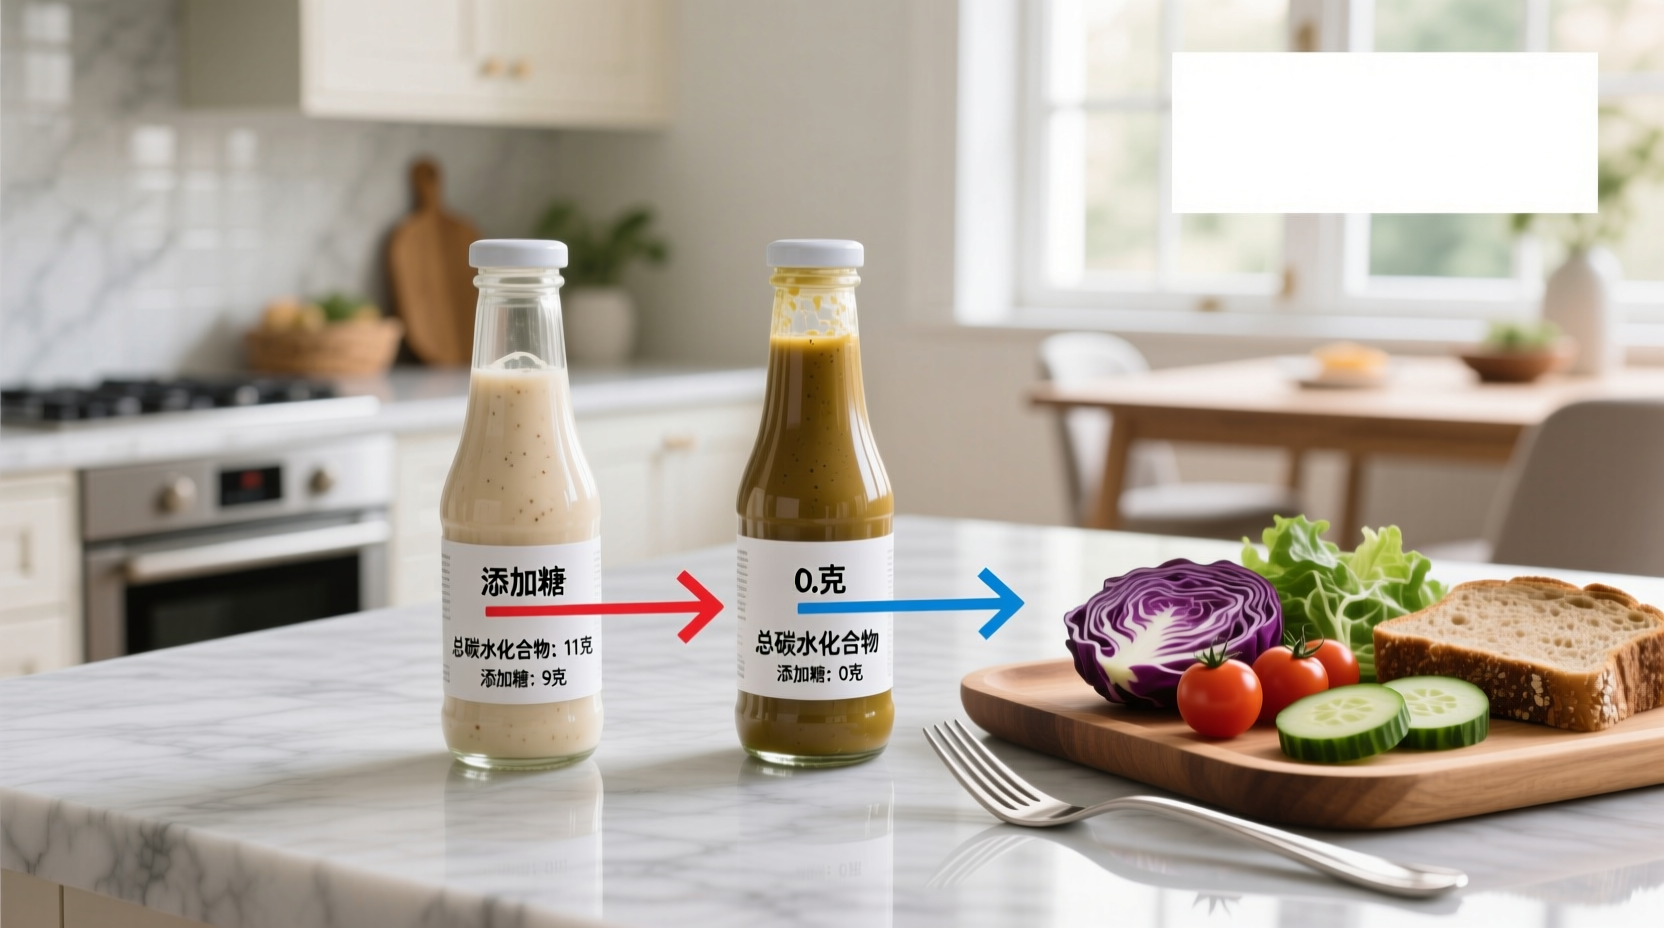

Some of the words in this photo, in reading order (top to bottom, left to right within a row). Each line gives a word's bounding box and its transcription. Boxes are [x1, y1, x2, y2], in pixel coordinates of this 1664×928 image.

[481, 565, 567, 597] 添加糖
[794, 564, 847, 595] 0.克
[755, 628, 879, 657] 总碳水化合物
